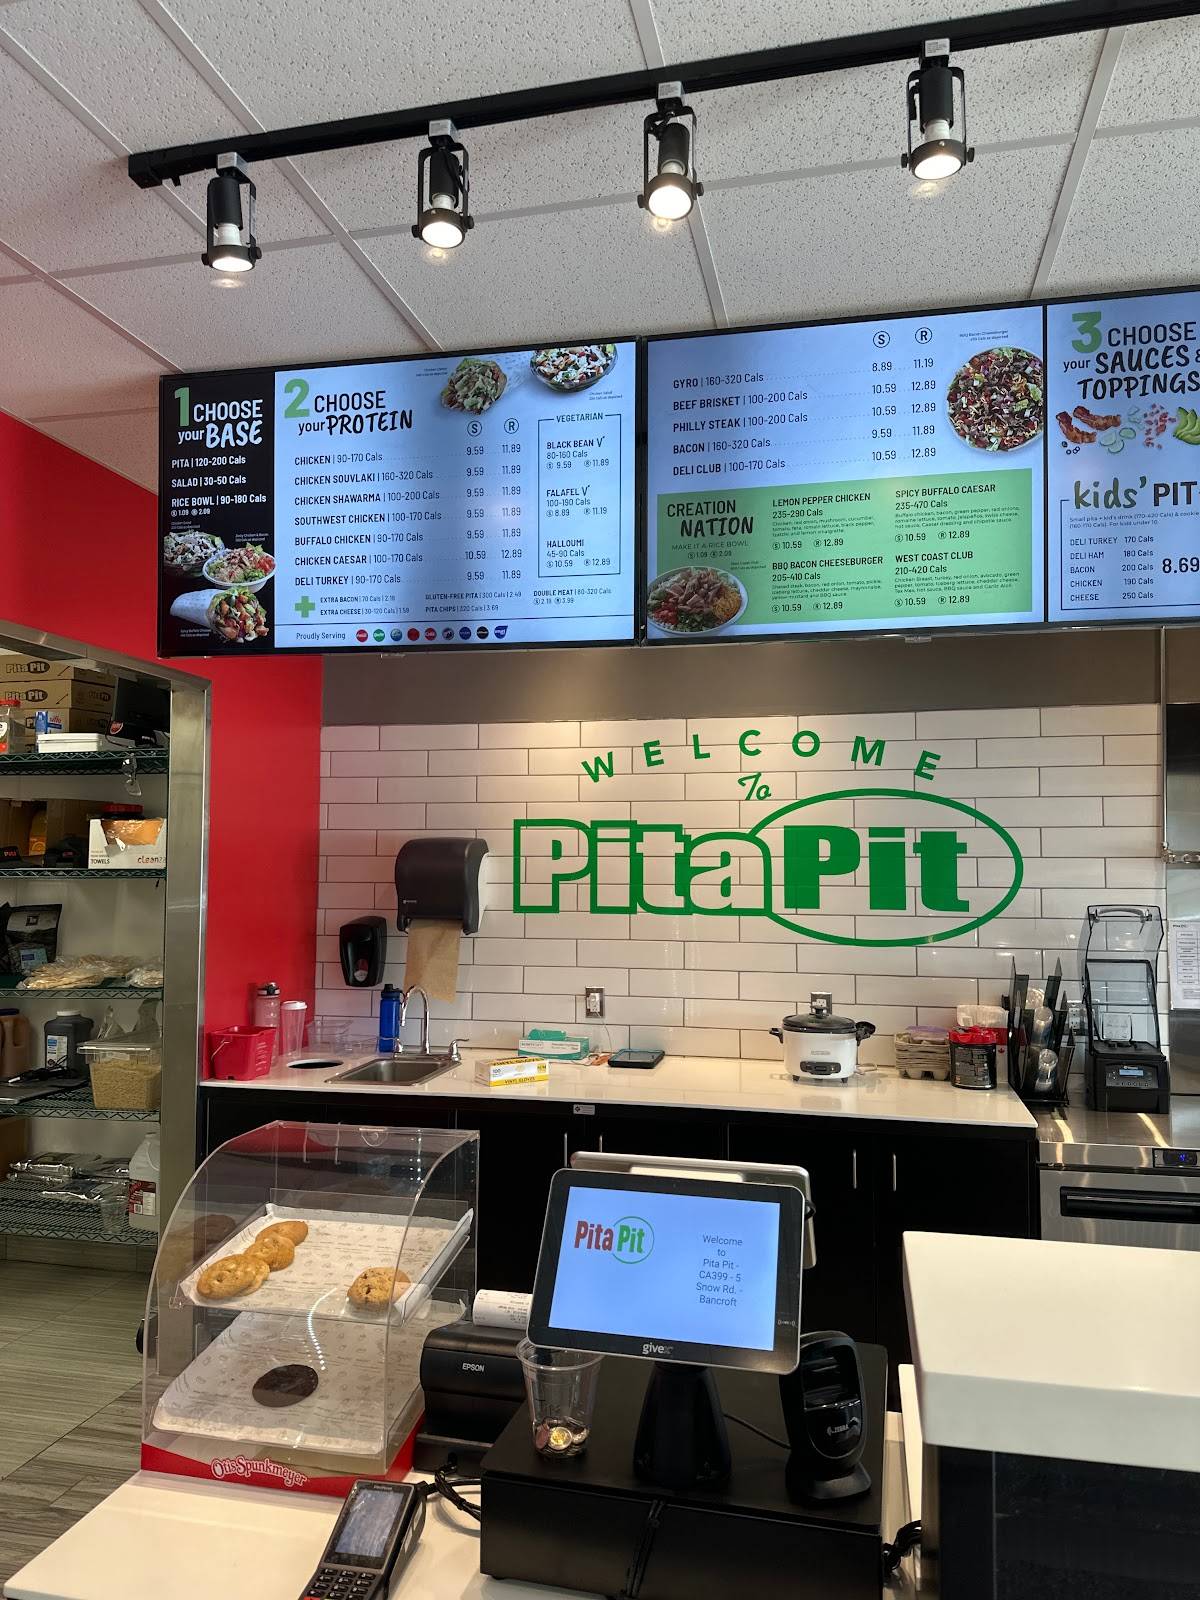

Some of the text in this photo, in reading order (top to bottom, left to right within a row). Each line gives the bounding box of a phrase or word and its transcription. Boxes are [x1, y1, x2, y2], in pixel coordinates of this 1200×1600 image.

[1072, 312, 1196, 353] 3 CHOOSE
[914, 358, 934, 368] 11.19
[1064, 360, 1090, 372] your
[1096, 345, 1190, 374] SAUCES
[872, 362, 892, 372] 8.89
[674, 373, 764, 388] GYRO 160-320 Cals
[912, 380, 936, 391] 12.89
[1077, 371, 1200, 400] TOPPINGS
[872, 384, 896, 394] 10.59
[284, 378, 386, 418] 2 CHOOSE
[674, 392, 808, 410] BEEF BRISKET 100-200 Cals
[174, 387, 262, 426] 1 CHOOSE
[872, 406, 896, 416] 10.59
[912, 402, 936, 413] 12.89
[556, 412, 604, 422] VEGETARIAN
[298, 410, 412, 436] your PROTEIN
[674, 414, 808, 432] PHILLY STEAK 100-200 Cals
[178, 420, 262, 448] your BASE
[872, 428, 892, 438] 9.59
[912, 425, 935, 436] 11.89
[502, 444, 520, 453] 11.89
[546, 440, 594, 450] BLACK BEAN
[674, 438, 770, 454] BACON Cals
[466, 446, 484, 456] 9.59
[572, 450, 588, 458] Cals
[872, 450, 896, 460] 10.59
[912, 448, 936, 458] 12.89
[172, 455, 246, 468] PITA 120-200 Cals
[294, 452, 383, 466] CHICKEN Cals
[466, 467, 484, 476] 9.59
[502, 465, 520, 474] 11.89
[674, 459, 786, 476] DELI CLUB Cals
[172, 474, 246, 488] SALAD 30-50 Cals
[294, 473, 376, 486] CHICKEN SOUVLAKI
[466, 488, 484, 498] 9.59
[502, 486, 520, 496] 11.89
[546, 488, 580, 496] FALAFEL
[896, 484, 996, 498] SPICY BUFFALO CAESAR
[1074, 476, 1200, 509] kids' PIT
[172, 493, 266, 507] RICE BOWL 90-180 Cals
[294, 493, 380, 506] CHICKEN SHAWARMA
[772, 493, 871, 507] LEMON PEPPER CHICKEN
[930, 500, 948, 508] Cals
[466, 509, 484, 518] 9.59
[502, 507, 520, 516] 11.89
[668, 500, 736, 517] CREATION
[806, 508, 823, 516] Cals
[294, 511, 442, 526] SOUTHWEST CHICKEN Cals
[680, 516, 754, 538] NATION
[466, 530, 484, 539] 9.59
[502, 528, 520, 538] 11.89
[294, 532, 424, 546] BUFFALO CHICKEN Cals
[546, 539, 584, 548] HALLOUMI
[1089, 536, 1117, 545] TURKEY
[465, 551, 486, 560] 10.59
[501, 549, 522, 559] 12.89
[896, 551, 974, 562] WEST COAST CLUB
[295, 554, 367, 566] CHICKEN CAESAR
[772, 562, 788, 570] BBQ
[790, 560, 817, 568] BACON
[820, 556, 883, 567] CHEESEBURGER
[1162, 556, 1200, 574] 8.69
[295, 573, 401, 586] DELI TURKEY Cals
[466, 572, 484, 580] 9.59
[502, 570, 521, 580] 11.89
[1070, 580, 1102, 588] CHICKEN
[296, 632, 320, 642] Proudly
[322, 631, 346, 641] Serving
[582, 730, 941, 782] WELCOME
[737, 772, 772, 800] To
[574, 1220, 645, 1254] Pita Pit
[702, 1235, 742, 1246] Welcome
[704, 1258, 734, 1270] Pita Pit
[700, 1271, 740, 1282] CA399 5
[696, 1282, 736, 1294] Snow Rd.
[700, 1295, 736, 1306] Bancroft
[462, 1362, 484, 1372] EPSON
